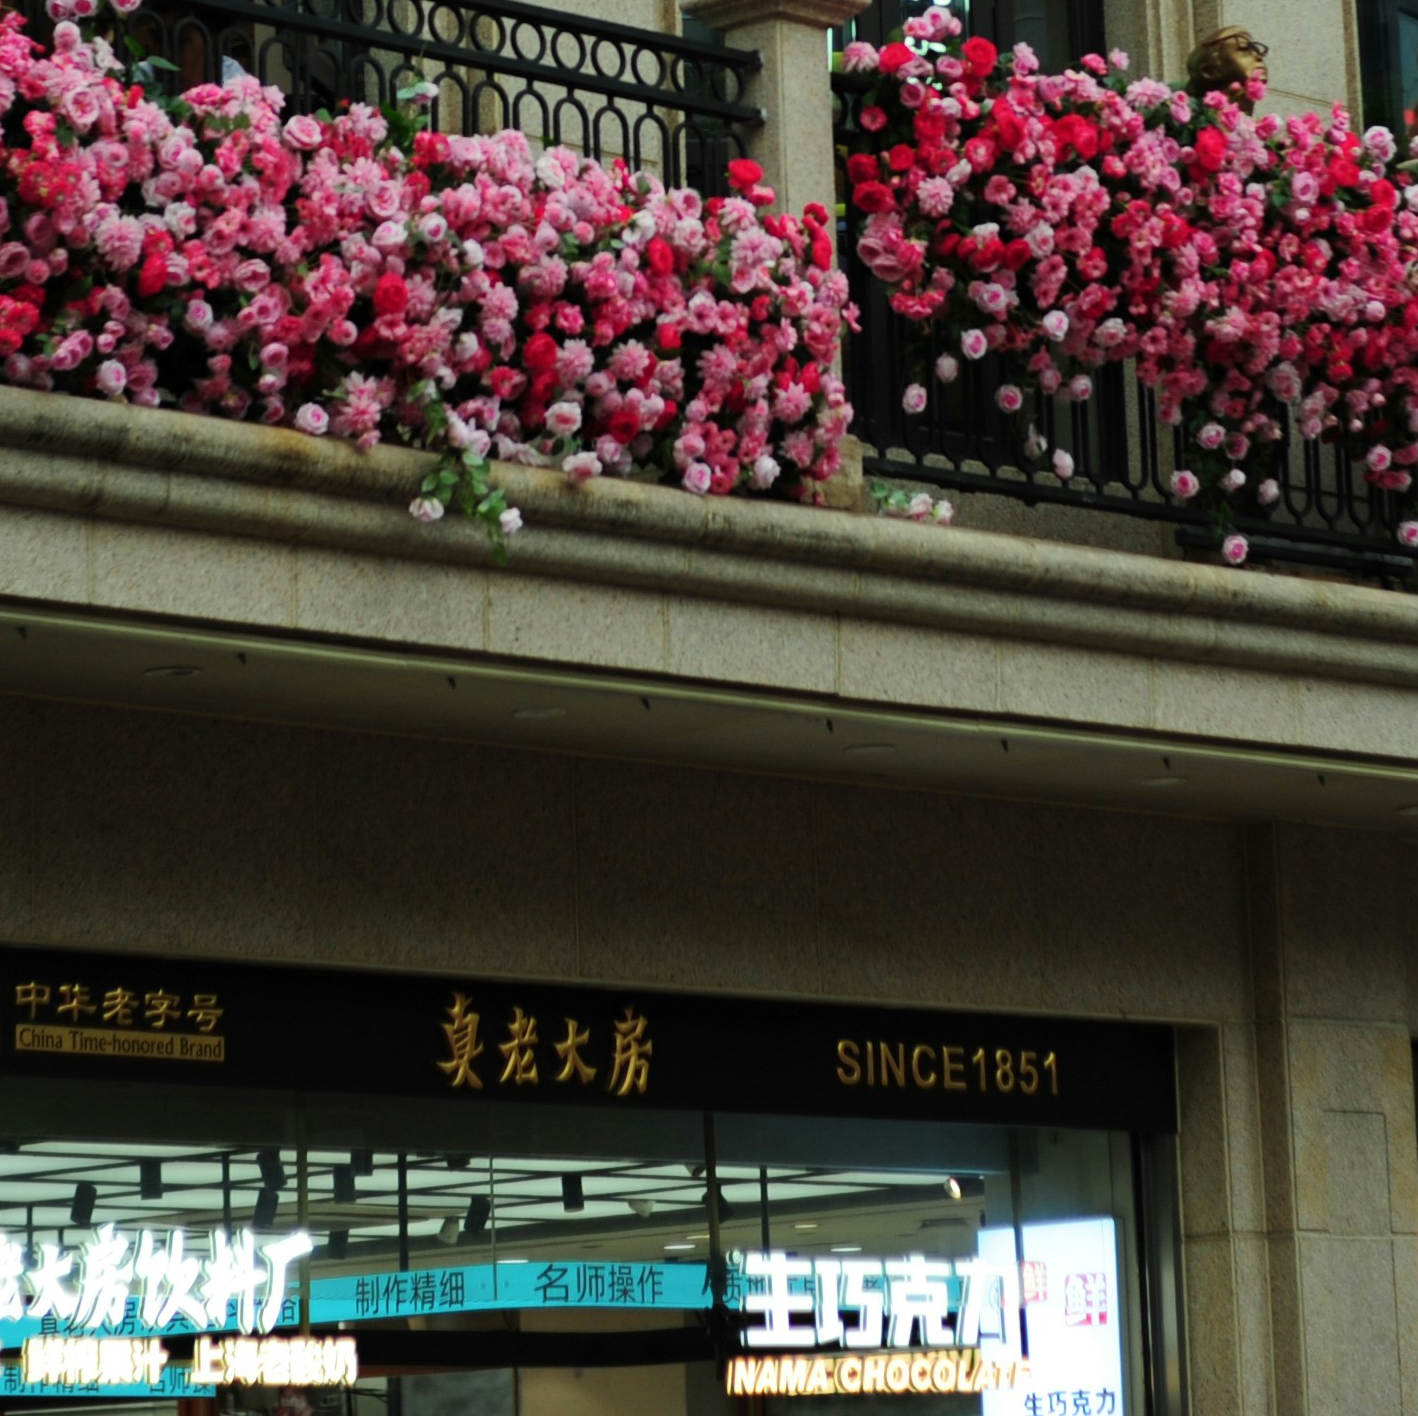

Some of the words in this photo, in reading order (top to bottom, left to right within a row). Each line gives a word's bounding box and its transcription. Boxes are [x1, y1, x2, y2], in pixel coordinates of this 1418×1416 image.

[15, 981, 225, 1033] 中华老字号
[19, 1027, 63, 1050] China
[68, 1030, 175, 1056] Time-honored
[180, 1036, 223, 1059] Brand
[354, 1270, 466, 1316] 制作精细
[534, 1263, 665, 1305] 名师操作
[727, 1355, 834, 1395] NAMA
[1024, 1387, 1116, 1416] 生巧克力
